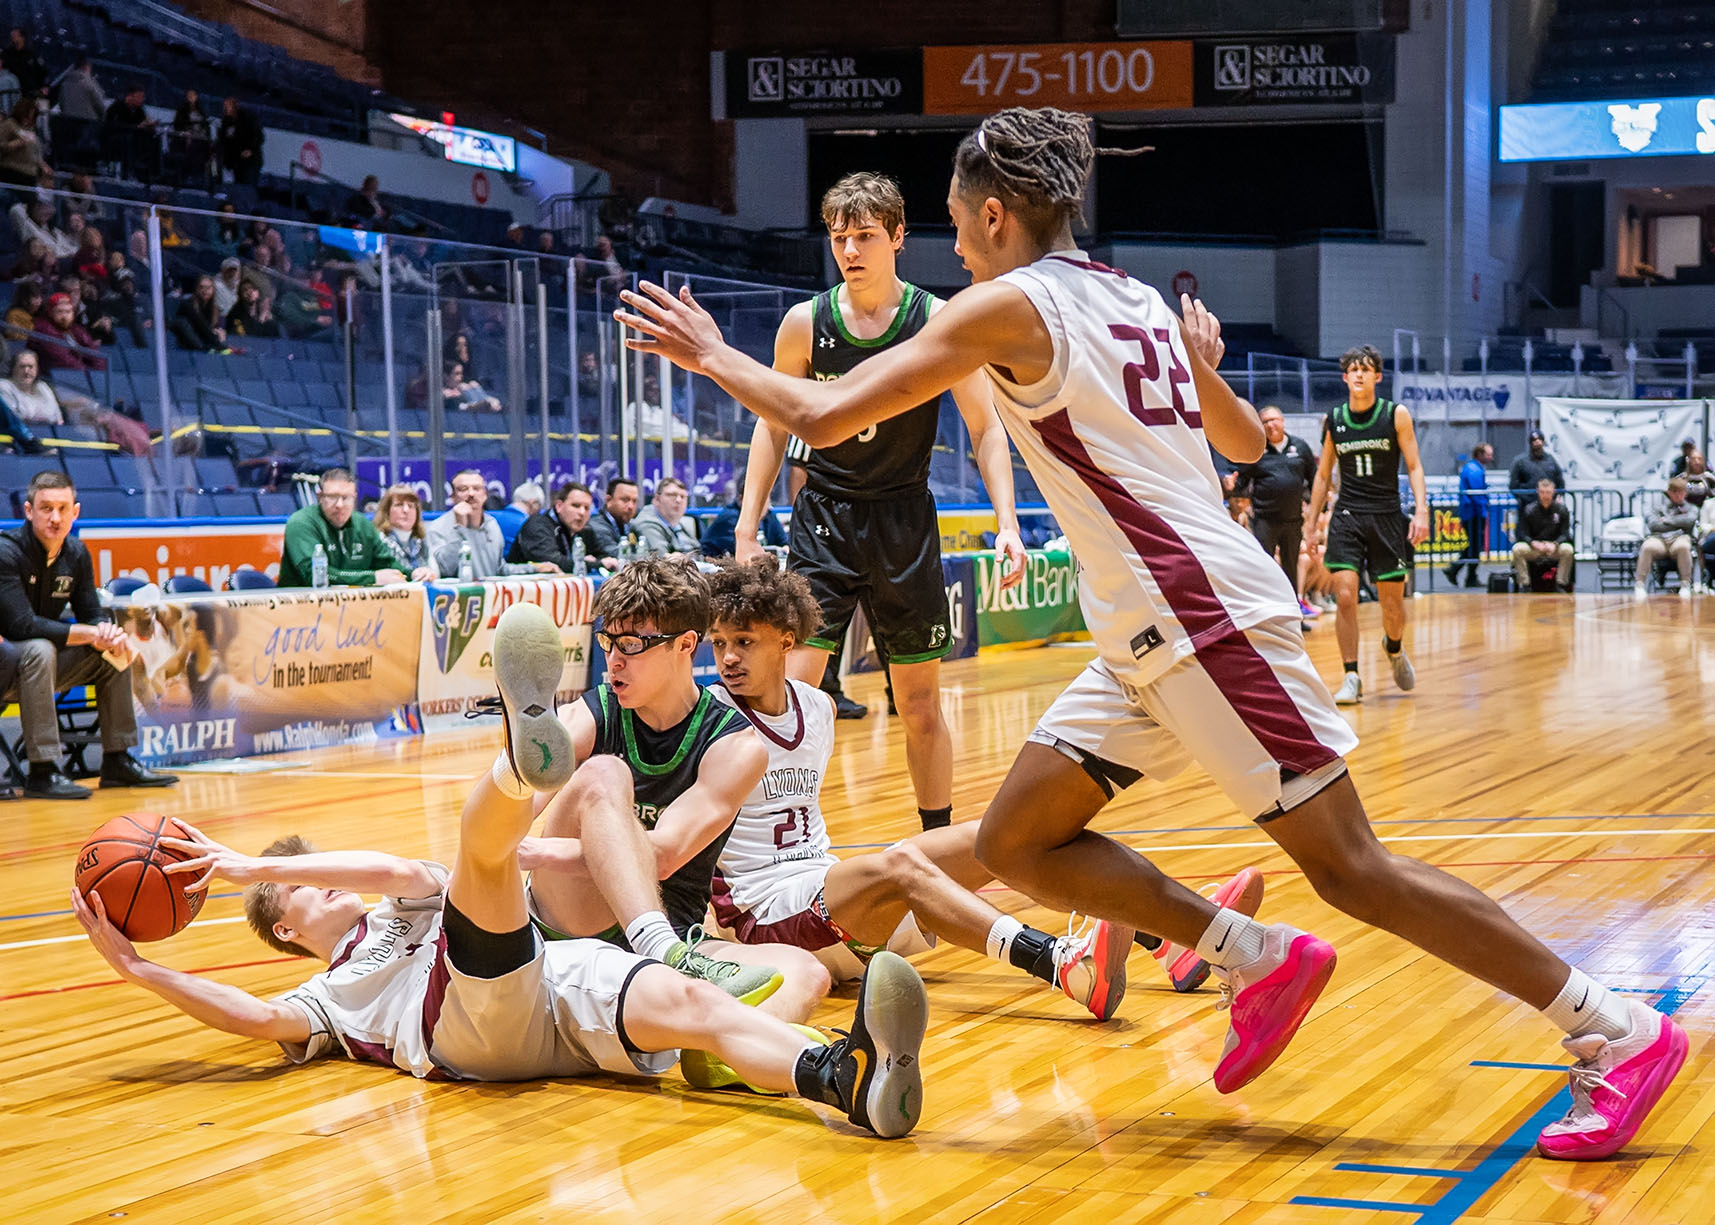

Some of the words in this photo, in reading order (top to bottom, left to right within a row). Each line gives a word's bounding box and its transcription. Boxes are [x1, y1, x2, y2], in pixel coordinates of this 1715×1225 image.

[786, 57, 857, 77] SEGAR
[1253, 44, 1325, 66] SEGAR
[787, 77, 902, 99] SCIORTINO
[961, 49, 1155, 96] 475-1100
[1254, 65, 1371, 88] SCIORTINO
[1107, 323, 1204, 429] 22
[1354, 453, 1373, 477] 11
[253, 612, 326, 685] good
[336, 604, 387, 648] luck
[273, 664, 285, 688] in
[287, 661, 306, 687] the
[308, 655, 373, 685] tournament!
[140, 718, 237, 757] RALPH
[762, 768, 819, 801] LYONS
[768, 806, 812, 851] 21
